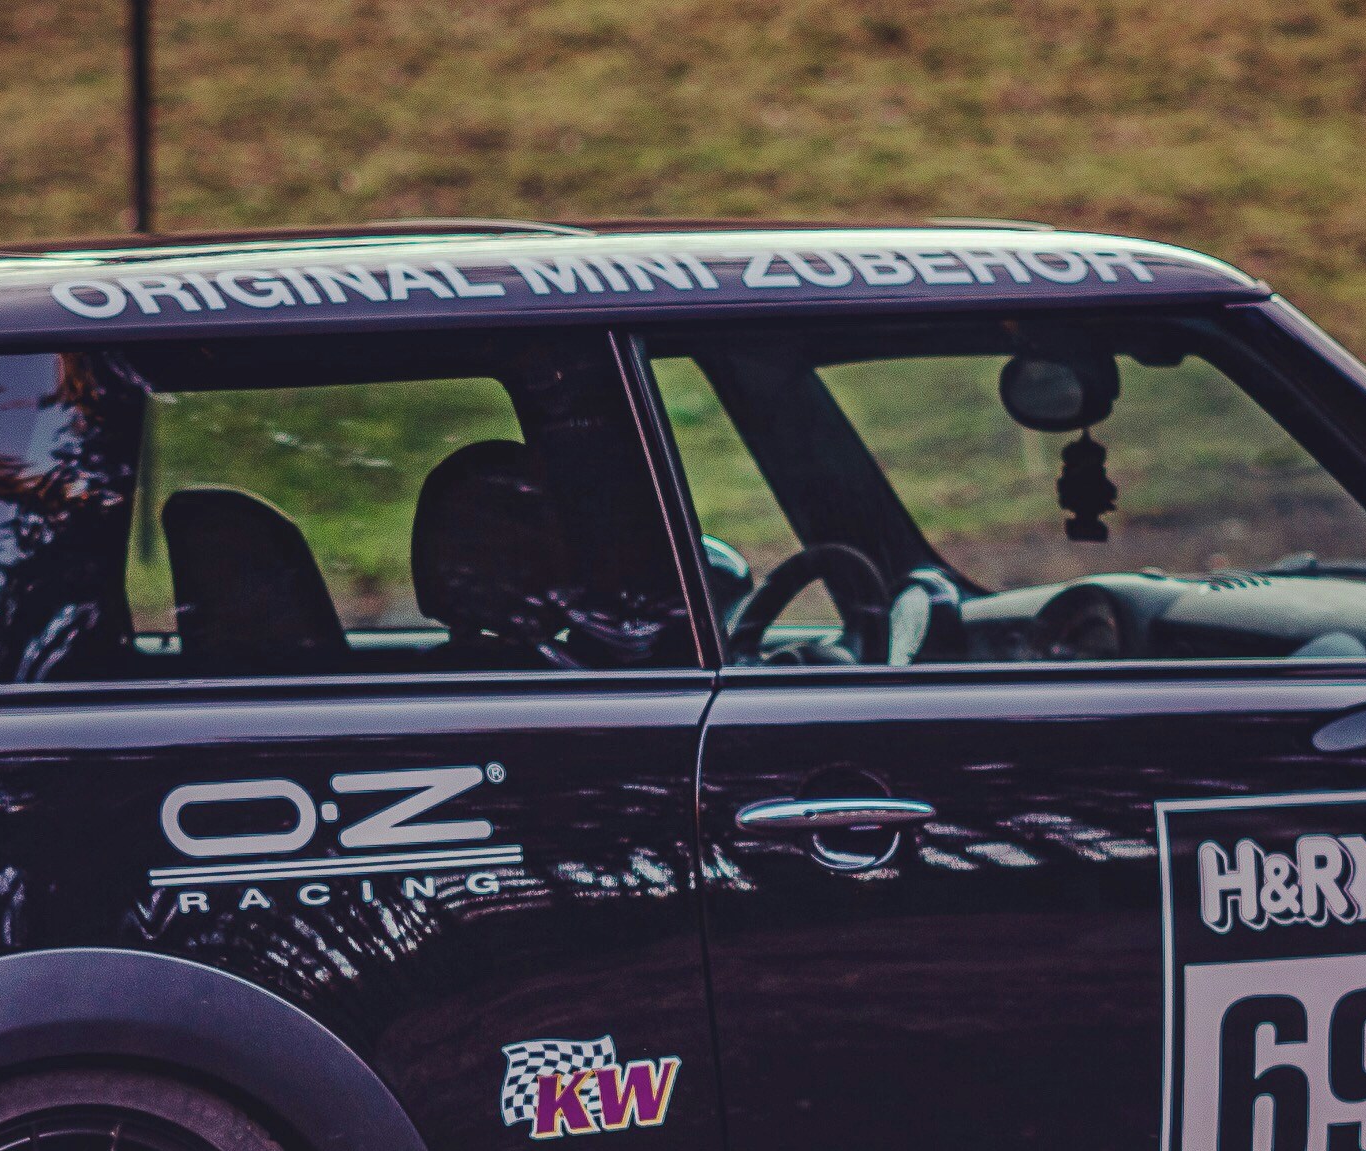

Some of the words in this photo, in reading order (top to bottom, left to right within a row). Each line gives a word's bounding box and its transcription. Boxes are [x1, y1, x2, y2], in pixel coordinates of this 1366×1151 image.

[50, 260, 505, 319] ORIGINAL
[507, 254, 720, 296] MINI
[178, 870, 500, 914] RACING
[531, 1057, 682, 1139] KW
